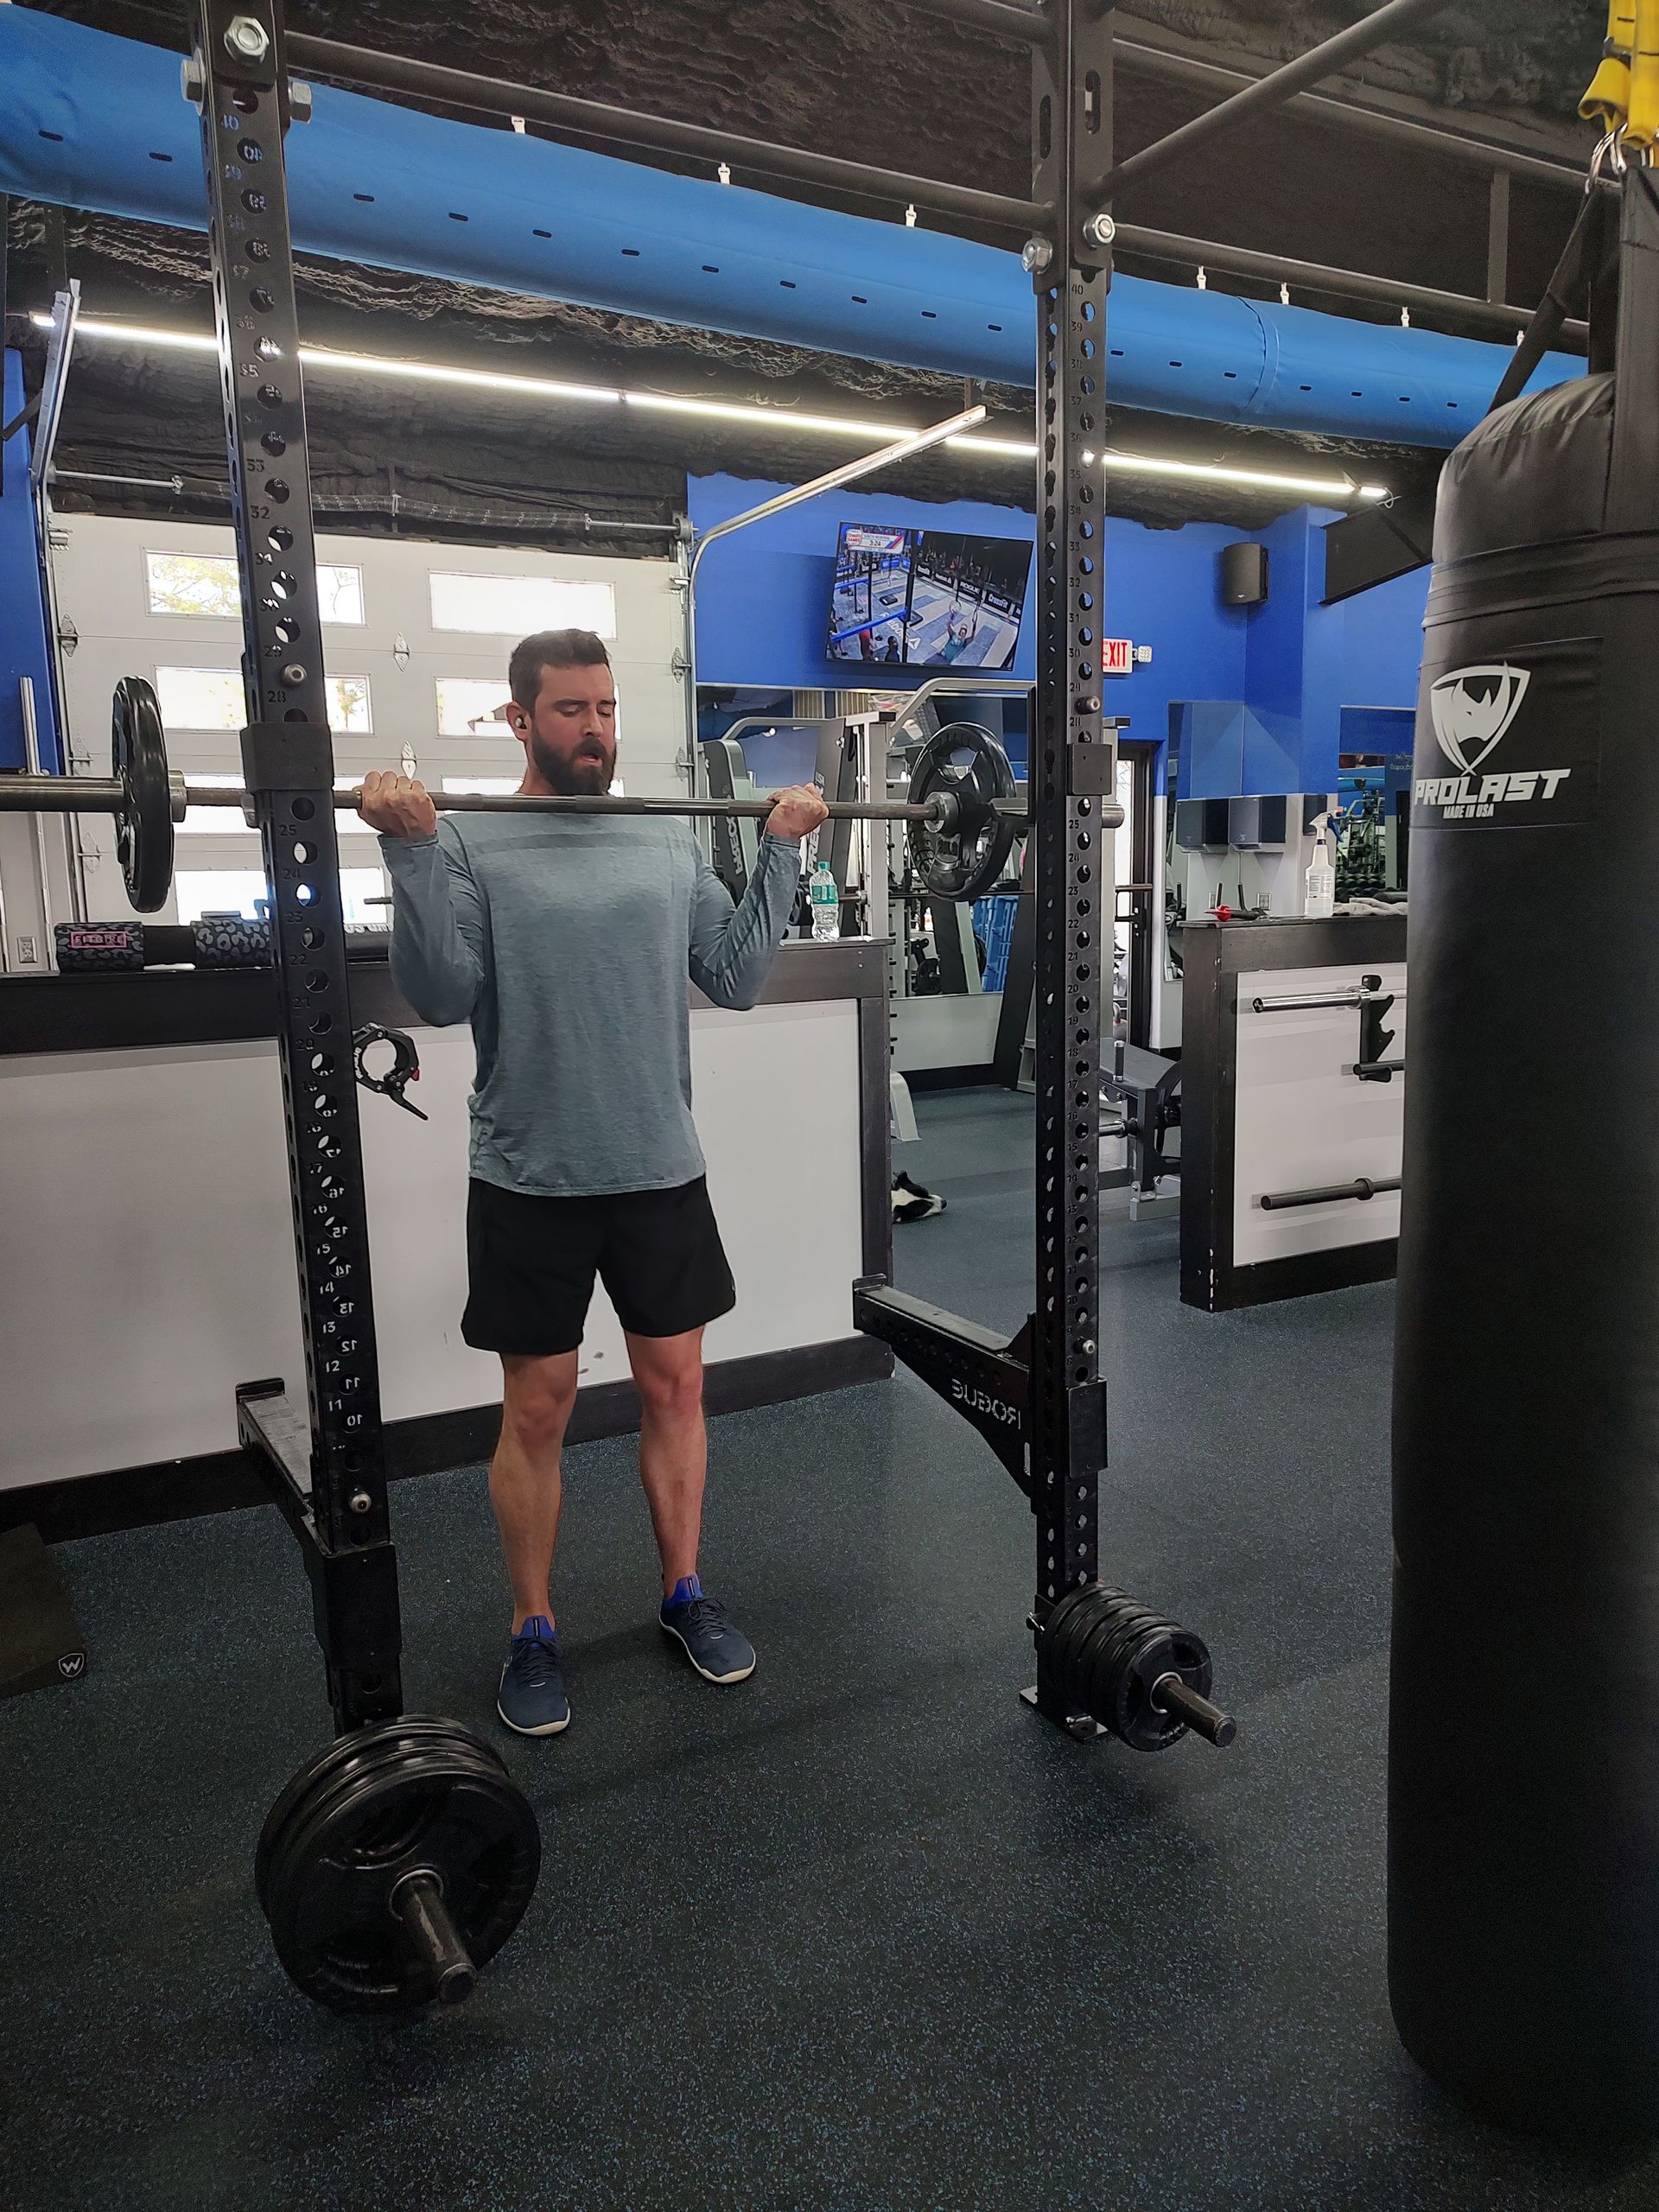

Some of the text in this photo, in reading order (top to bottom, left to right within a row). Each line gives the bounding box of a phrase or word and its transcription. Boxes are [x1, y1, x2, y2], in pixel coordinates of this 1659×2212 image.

[1071, 284, 1084, 295] 40
[250, 505, 270, 519] 32
[1069, 541, 1080, 551] 33
[960, 581, 981, 594] ROGUE
[1069, 577, 1080, 588] 32
[1069, 613, 1079, 622] 31
[1103, 641, 1128, 667] EXIT
[267, 690, 286, 703] 28
[1414, 768, 1572, 805] PROLAST
[1443, 804, 1466, 819] MADE
[1476, 803, 1495, 817] USA
[278, 823, 297, 836] 25
[1068, 819, 1079, 830] 25
[1068, 887, 1078, 896] 23
[1067, 919, 1078, 928] 22
[1067, 952, 1077, 961] 21
[1066, 984, 1078, 994] 20
[1067, 1016, 1078, 1026] 19
[1067, 1048, 1078, 1058] 18
[1067, 1079, 1078, 1089] 17
[1066, 1111, 1077, 1121] 16
[1066, 1142, 1077, 1152] 15
[320, 1281, 334, 1294] 14
[322, 1320, 336, 1333] 13
[326, 1359, 340, 1373] 12
[328, 1399, 342, 1412] 11
